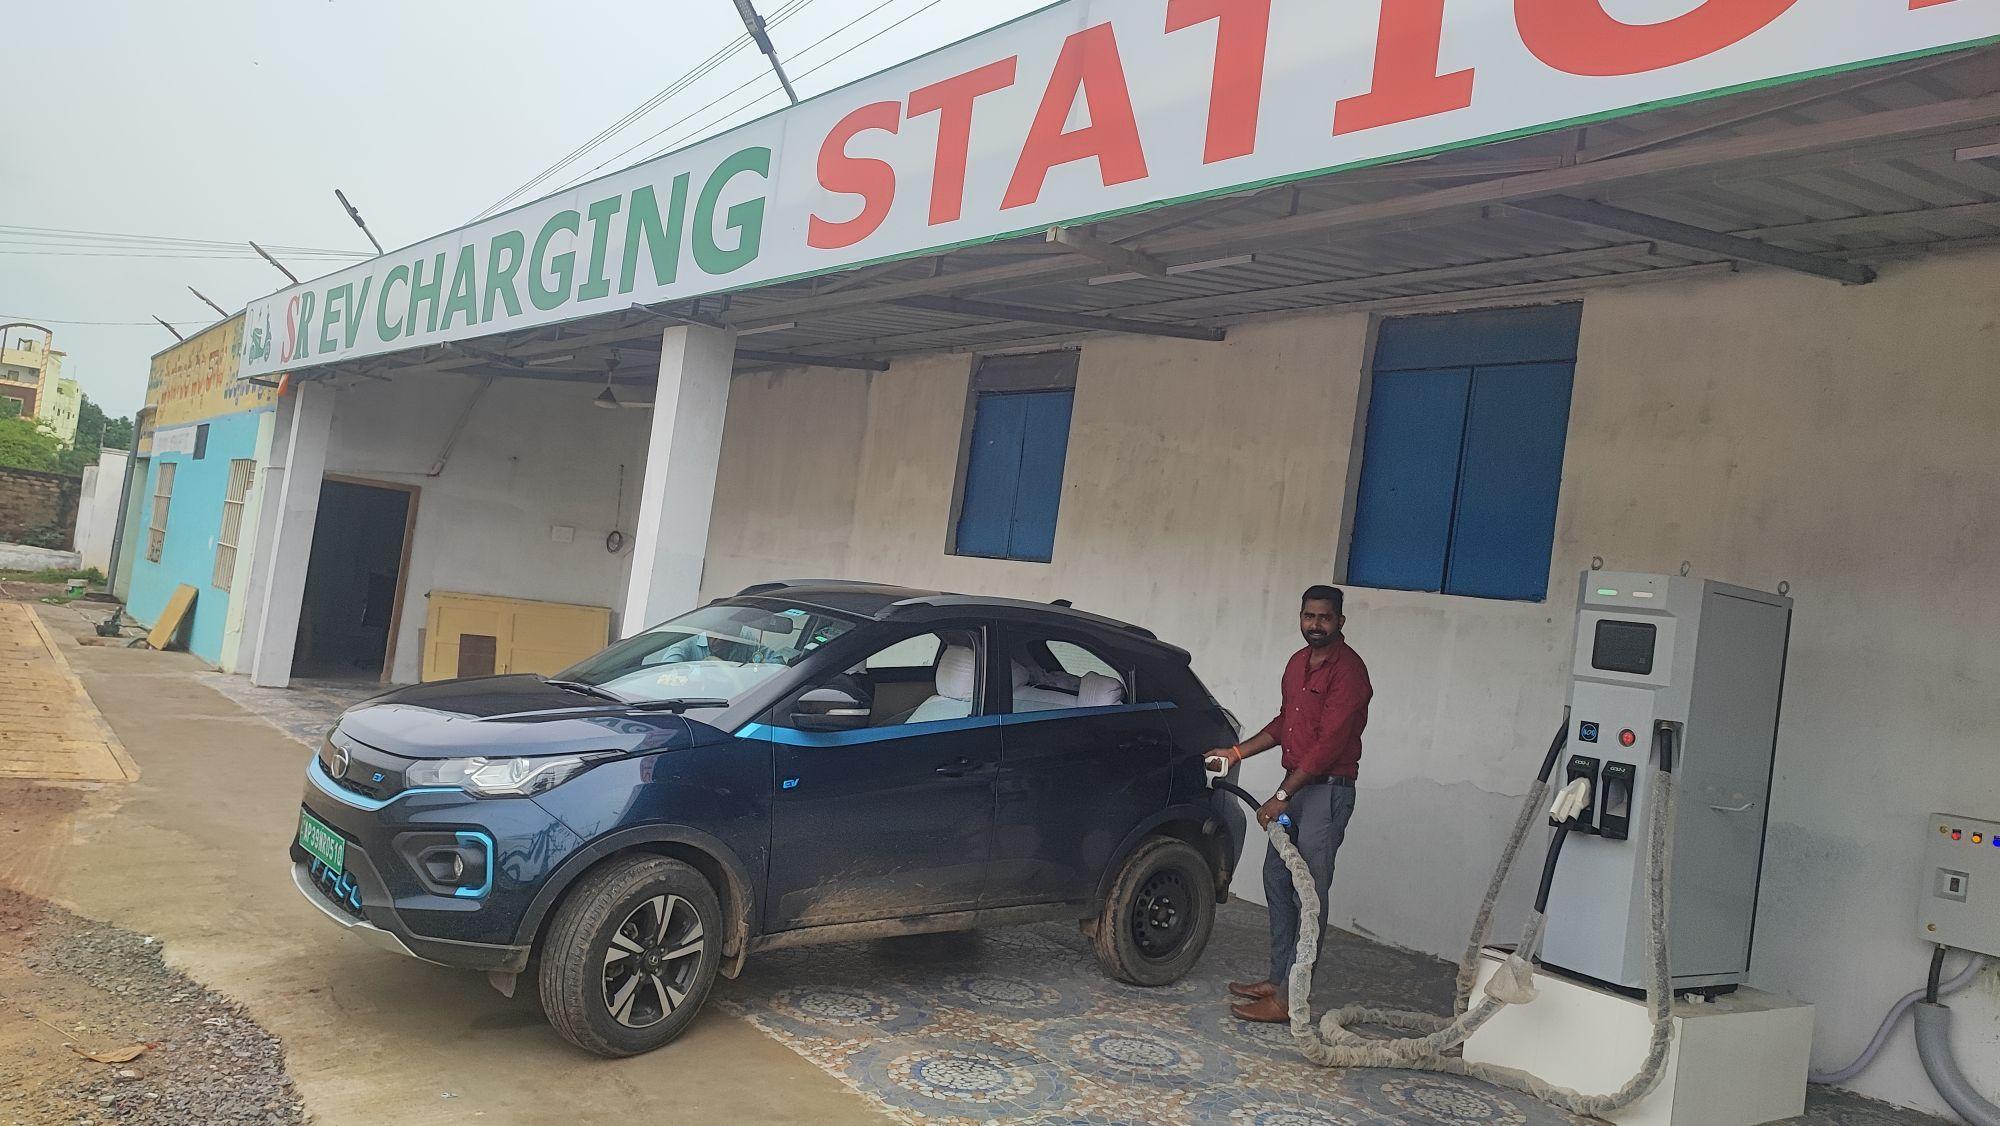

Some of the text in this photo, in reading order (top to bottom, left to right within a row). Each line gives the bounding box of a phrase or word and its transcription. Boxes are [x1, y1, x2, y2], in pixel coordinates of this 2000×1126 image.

[280, 0, 1960, 364] SR EV CHARGING STATI
[783, 778, 800, 788] EV
